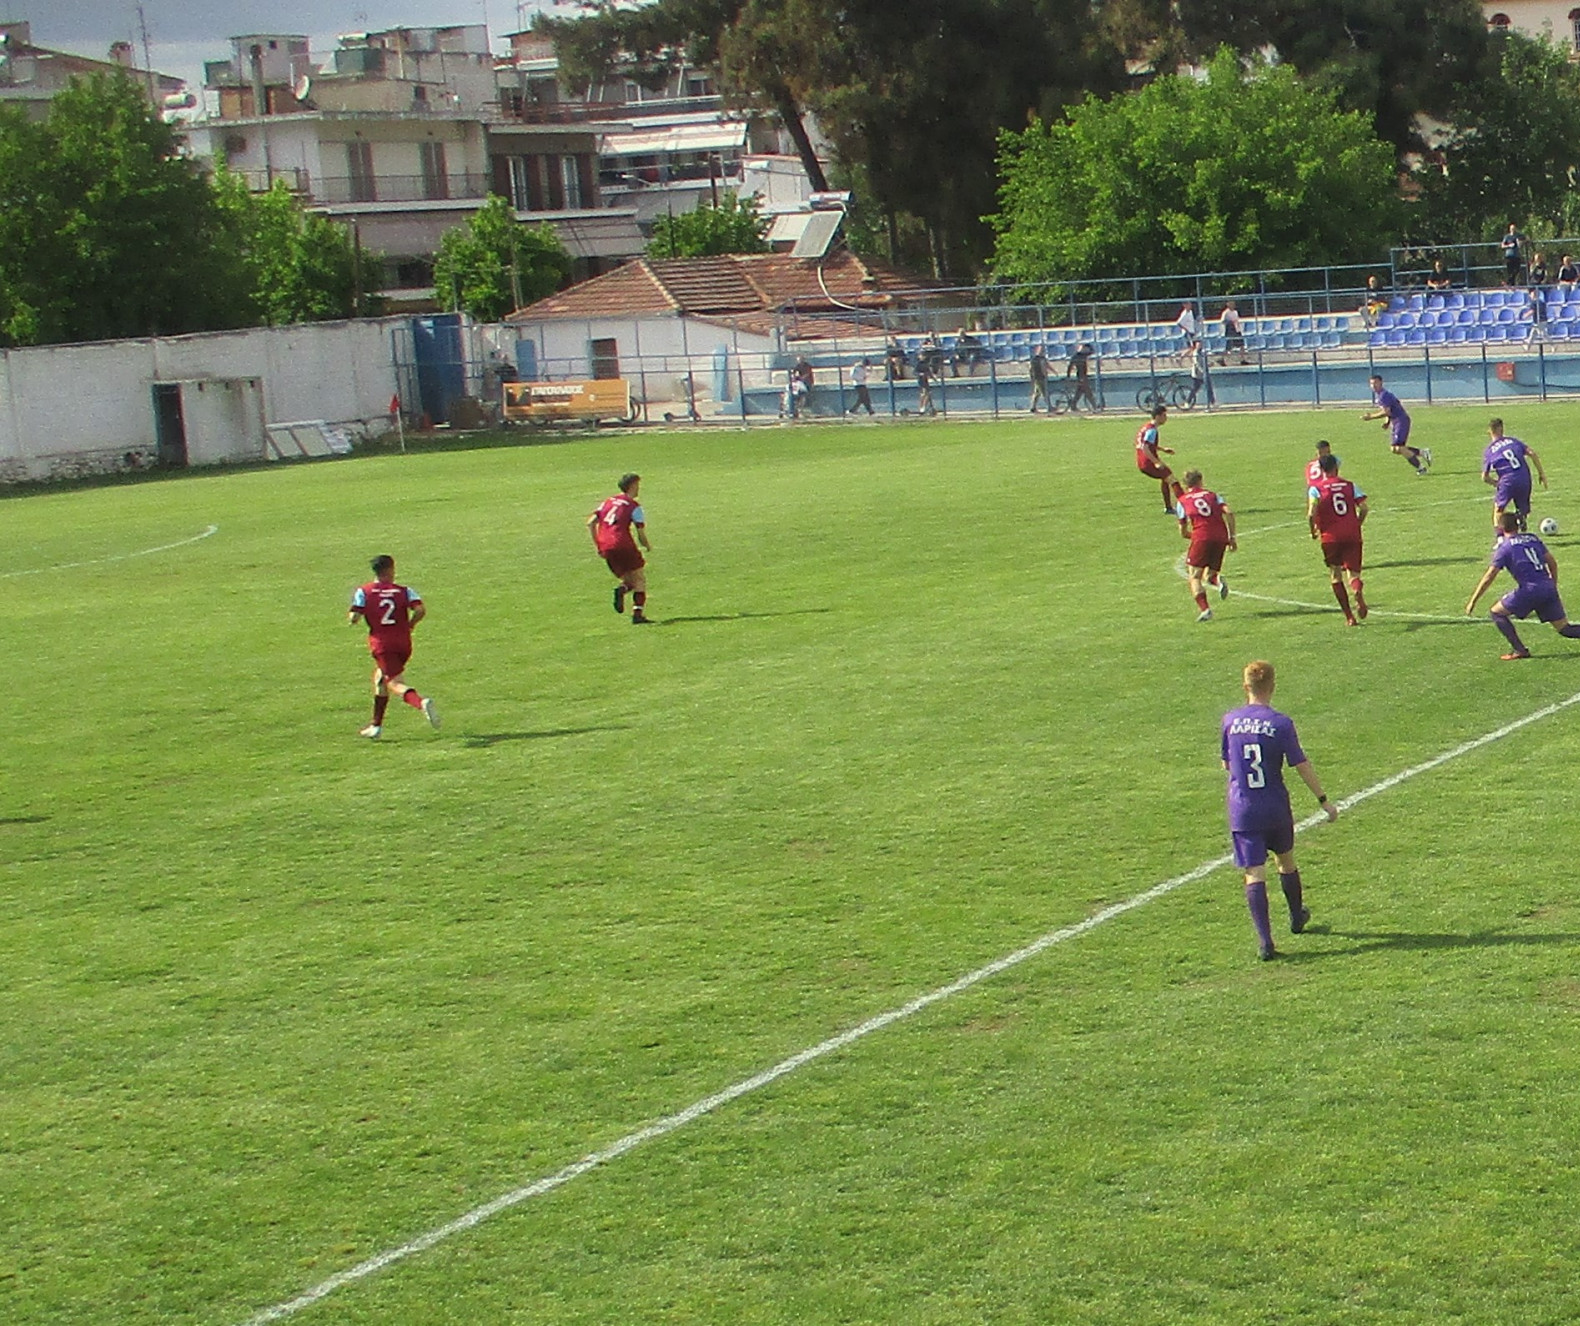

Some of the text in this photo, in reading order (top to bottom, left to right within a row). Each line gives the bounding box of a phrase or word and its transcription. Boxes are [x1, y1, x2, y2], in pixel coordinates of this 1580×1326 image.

[1503, 449, 1521, 469] 8
[1194, 498, 1212, 517] 8
[1333, 492, 1348, 516] 6
[603, 505, 618, 526] 4
[379, 598, 396, 625] 2
[1243, 743, 1265, 788] 3
